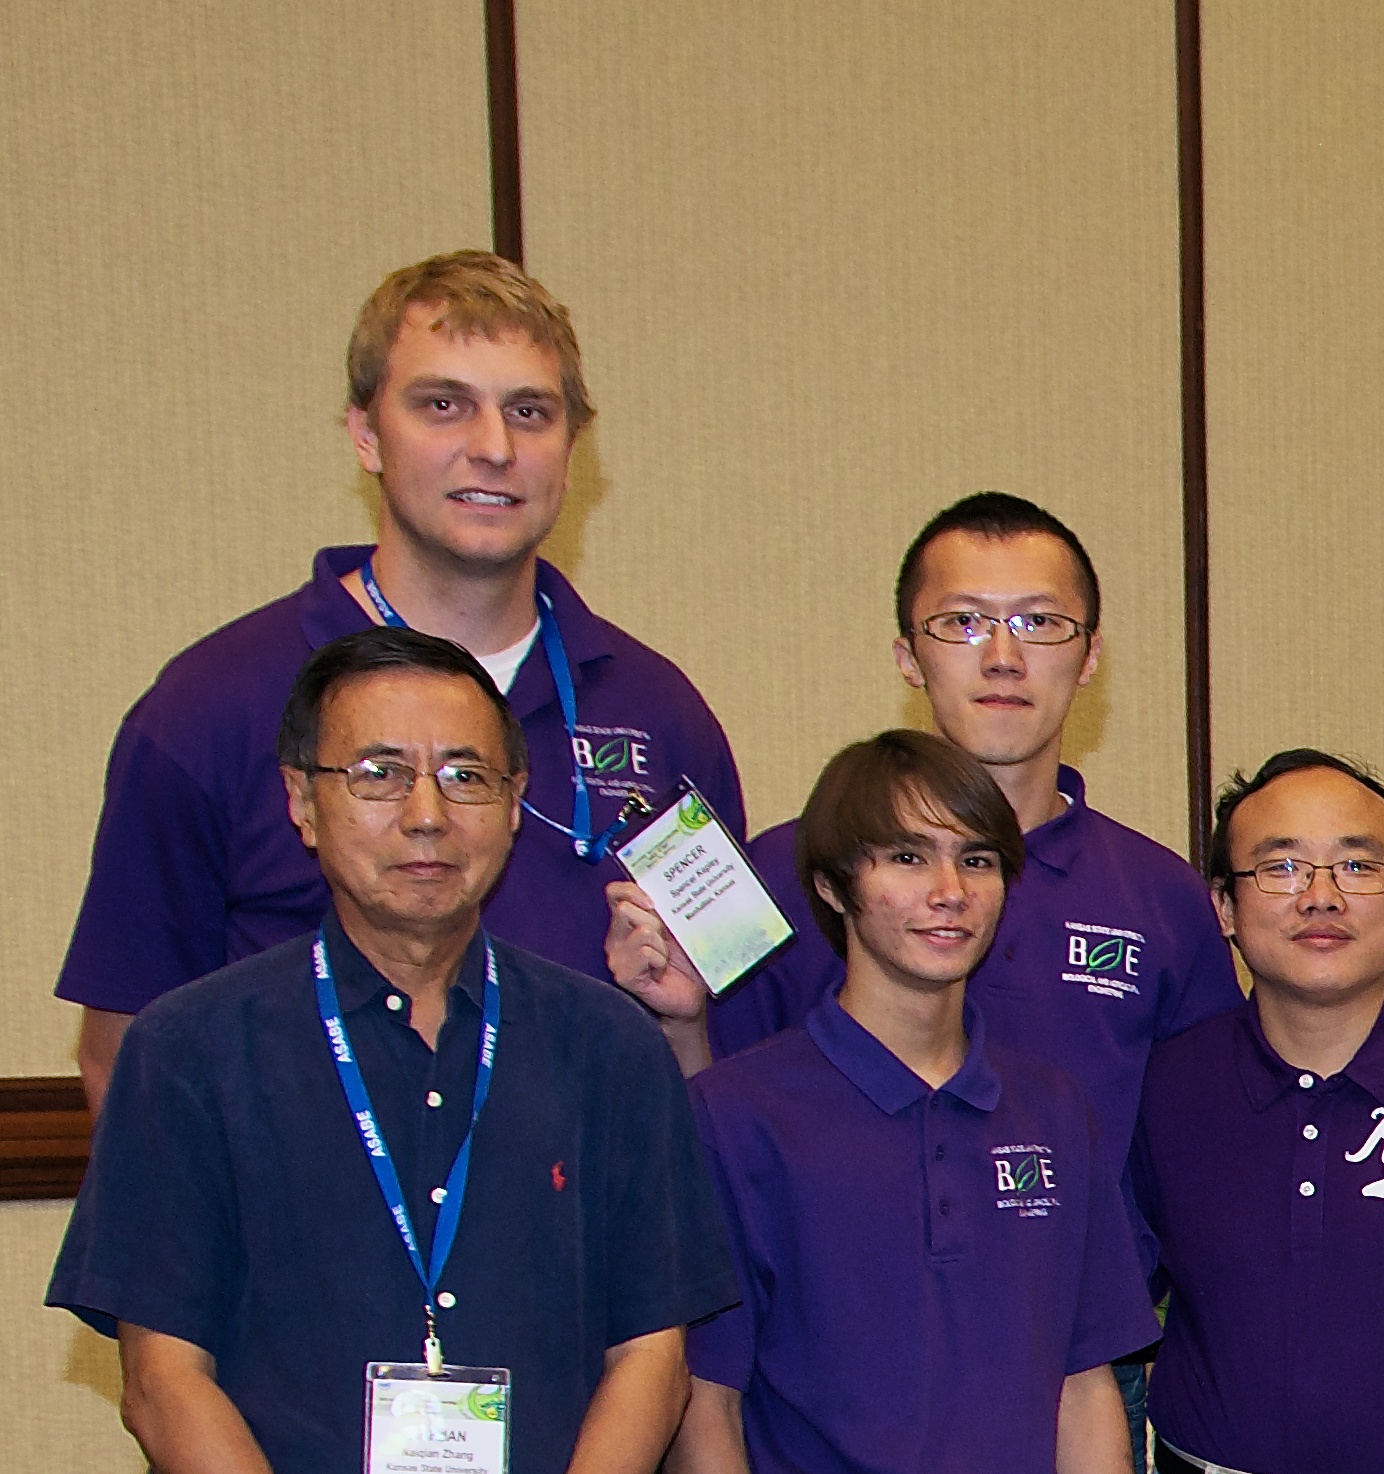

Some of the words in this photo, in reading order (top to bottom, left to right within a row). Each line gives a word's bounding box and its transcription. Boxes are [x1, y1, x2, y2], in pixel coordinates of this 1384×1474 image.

[664, 844, 707, 881] SPENCER
[324, 1015, 353, 1064] ASABE
[481, 1022, 498, 1069] ASABE
[356, 1109, 386, 1158] ASABE
[442, 1449, 473, 1462] Zhang
